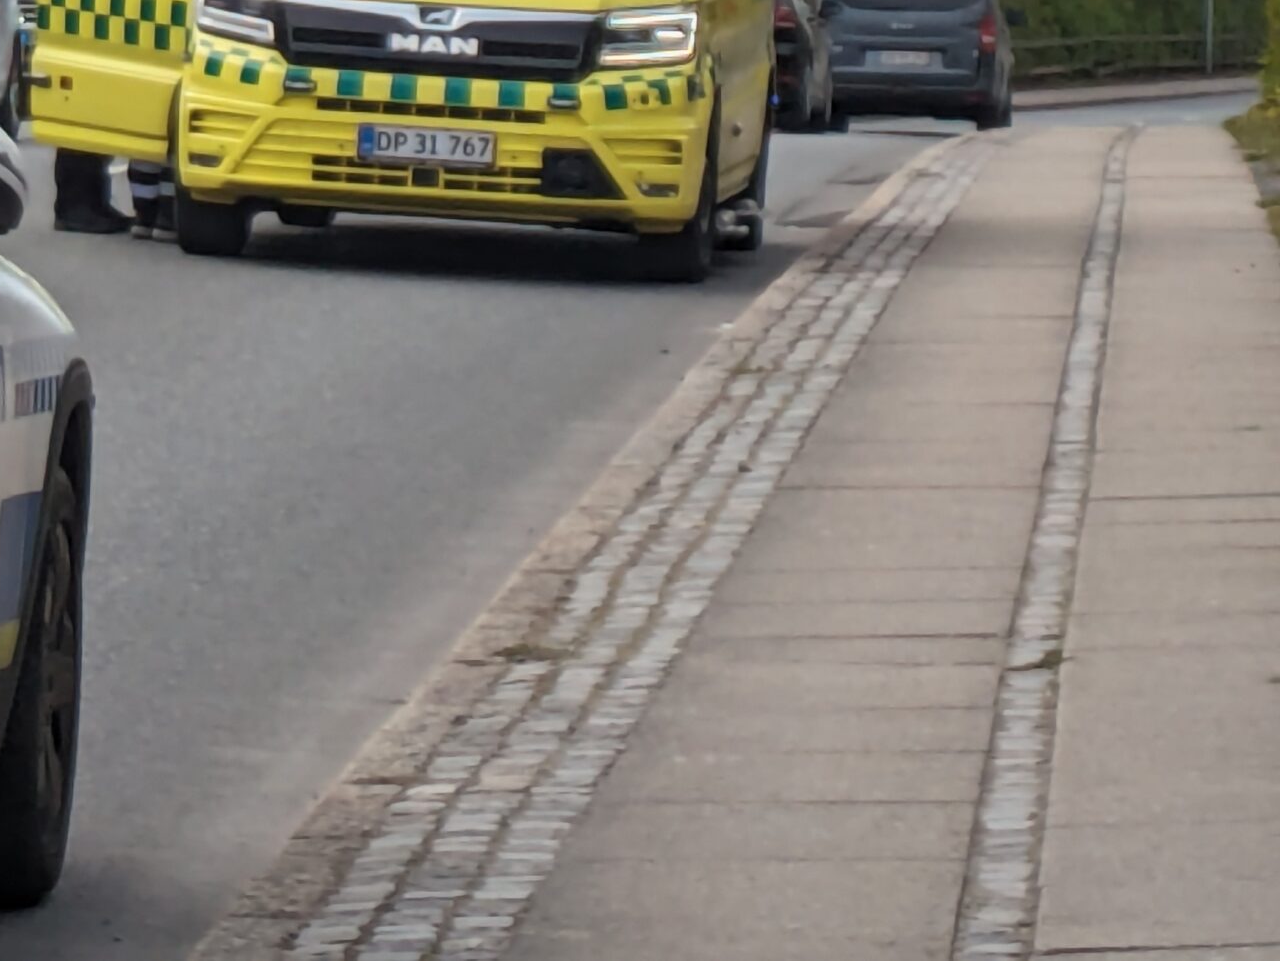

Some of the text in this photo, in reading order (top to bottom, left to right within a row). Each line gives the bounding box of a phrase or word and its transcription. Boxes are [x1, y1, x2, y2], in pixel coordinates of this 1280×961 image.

[389, 32, 478, 56] MAN
[376, 131, 490, 158] DP 31 767
